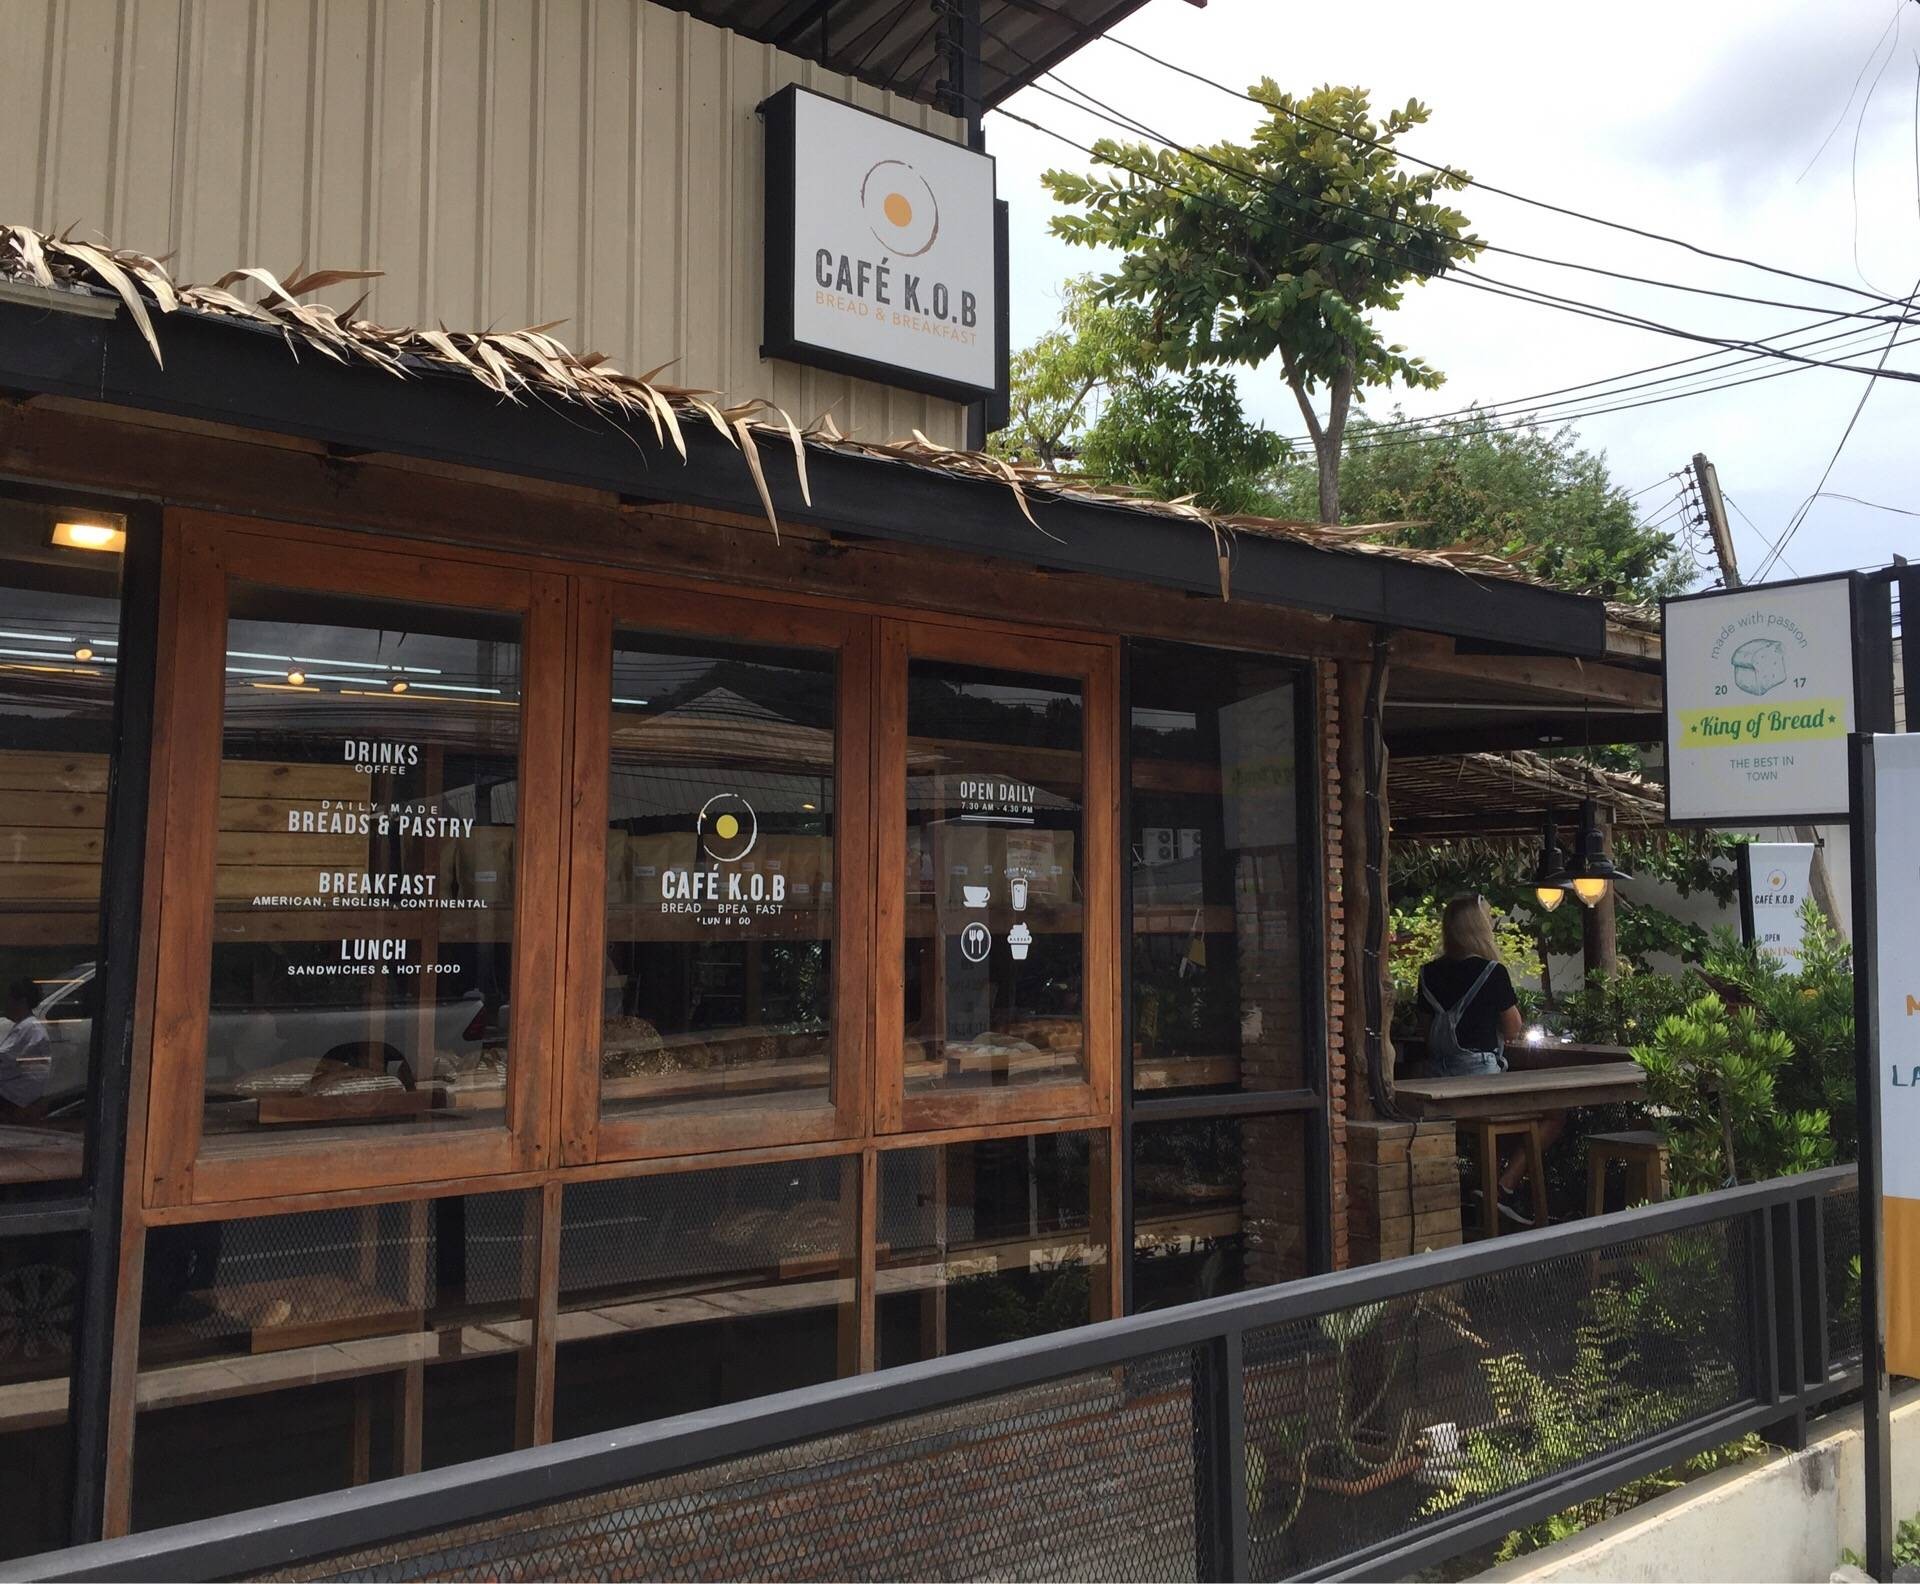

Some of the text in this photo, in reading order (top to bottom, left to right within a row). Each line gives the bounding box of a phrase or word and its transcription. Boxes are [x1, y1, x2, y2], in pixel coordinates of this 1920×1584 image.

[815, 248, 977, 328] CAFÉ K.O.B
[815, 290, 977, 346] BREAD & BREAKFAST
[1711, 610, 1809, 660] made with passion
[1714, 677, 1807, 696] 20 17
[1700, 708, 1826, 740] King of Bread
[344, 740, 419, 766] DRINKS
[1730, 755, 1795, 769] THE BEST IN
[354, 764, 407, 776] COFFEE
[1746, 771, 1778, 782] TOWN
[960, 781, 1036, 804] OPEN DAILY
[321, 800, 439, 815] DAILY MADE
[981, 802, 995, 812] AM
[1022, 805, 1034, 814] PM
[287, 810, 474, 839] BREADS & PASTRY
[318, 872, 437, 896] BREAKFAST
[661, 863, 786, 902] CAFÉ K.O.B
[252, 896, 327, 908] AMERICAN,
[400, 899, 488, 909] CONTINENTAL
[661, 902, 702, 914] BREAD
[340, 939, 407, 961] LUNCH
[287, 963, 461, 976] SANDWICHES & HOT FOOD
